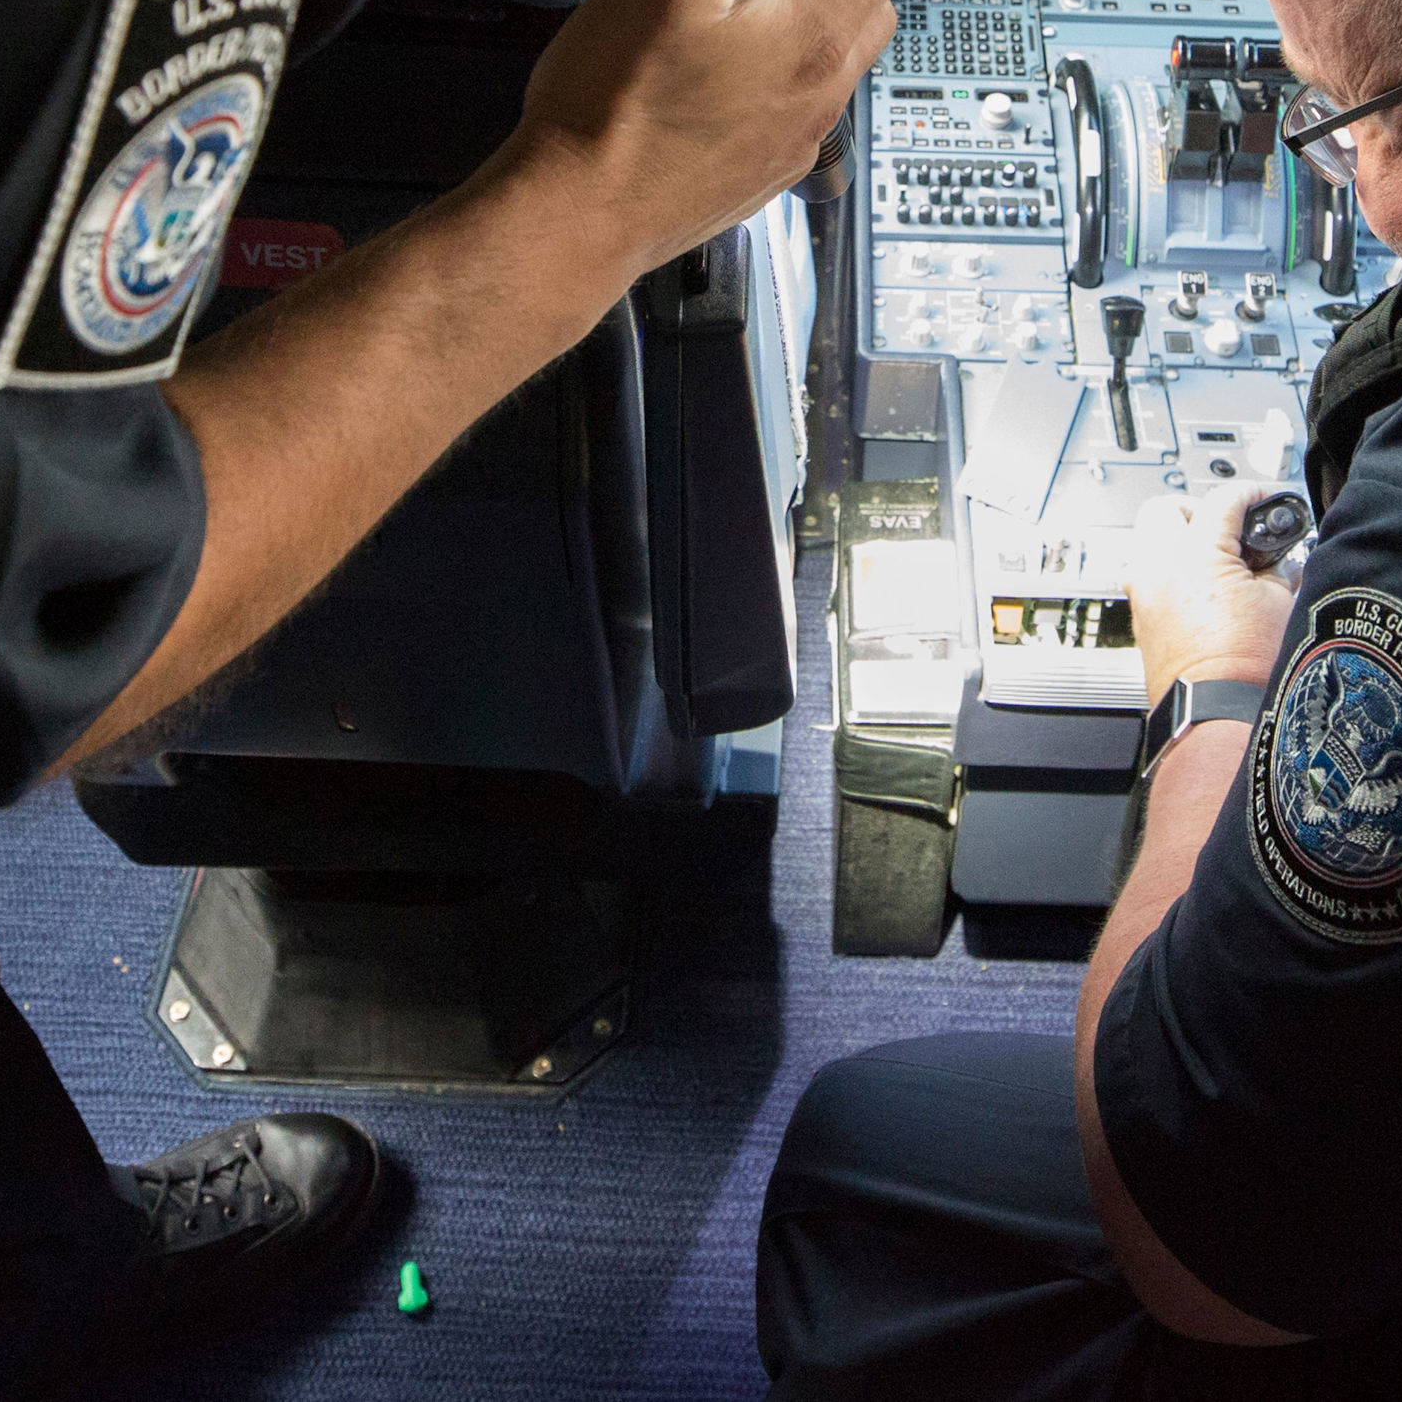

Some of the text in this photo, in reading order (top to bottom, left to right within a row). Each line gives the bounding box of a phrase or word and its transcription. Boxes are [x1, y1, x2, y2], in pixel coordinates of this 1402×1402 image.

[114, 26, 246, 125] BORDER
[241, 242, 328, 270] VEST
[1181, 273, 1205, 284] ENG
[1191, 284, 1197, 293] 1
[1250, 275, 1273, 286] ENG
[1258, 285, 1265, 296] 2
[868, 515, 923, 530] EVAS
[1355, 599, 1382, 624] U.S.
[1333, 618, 1395, 652] BORDER
[1254, 780, 1348, 920] FIELD OPERATIONS
